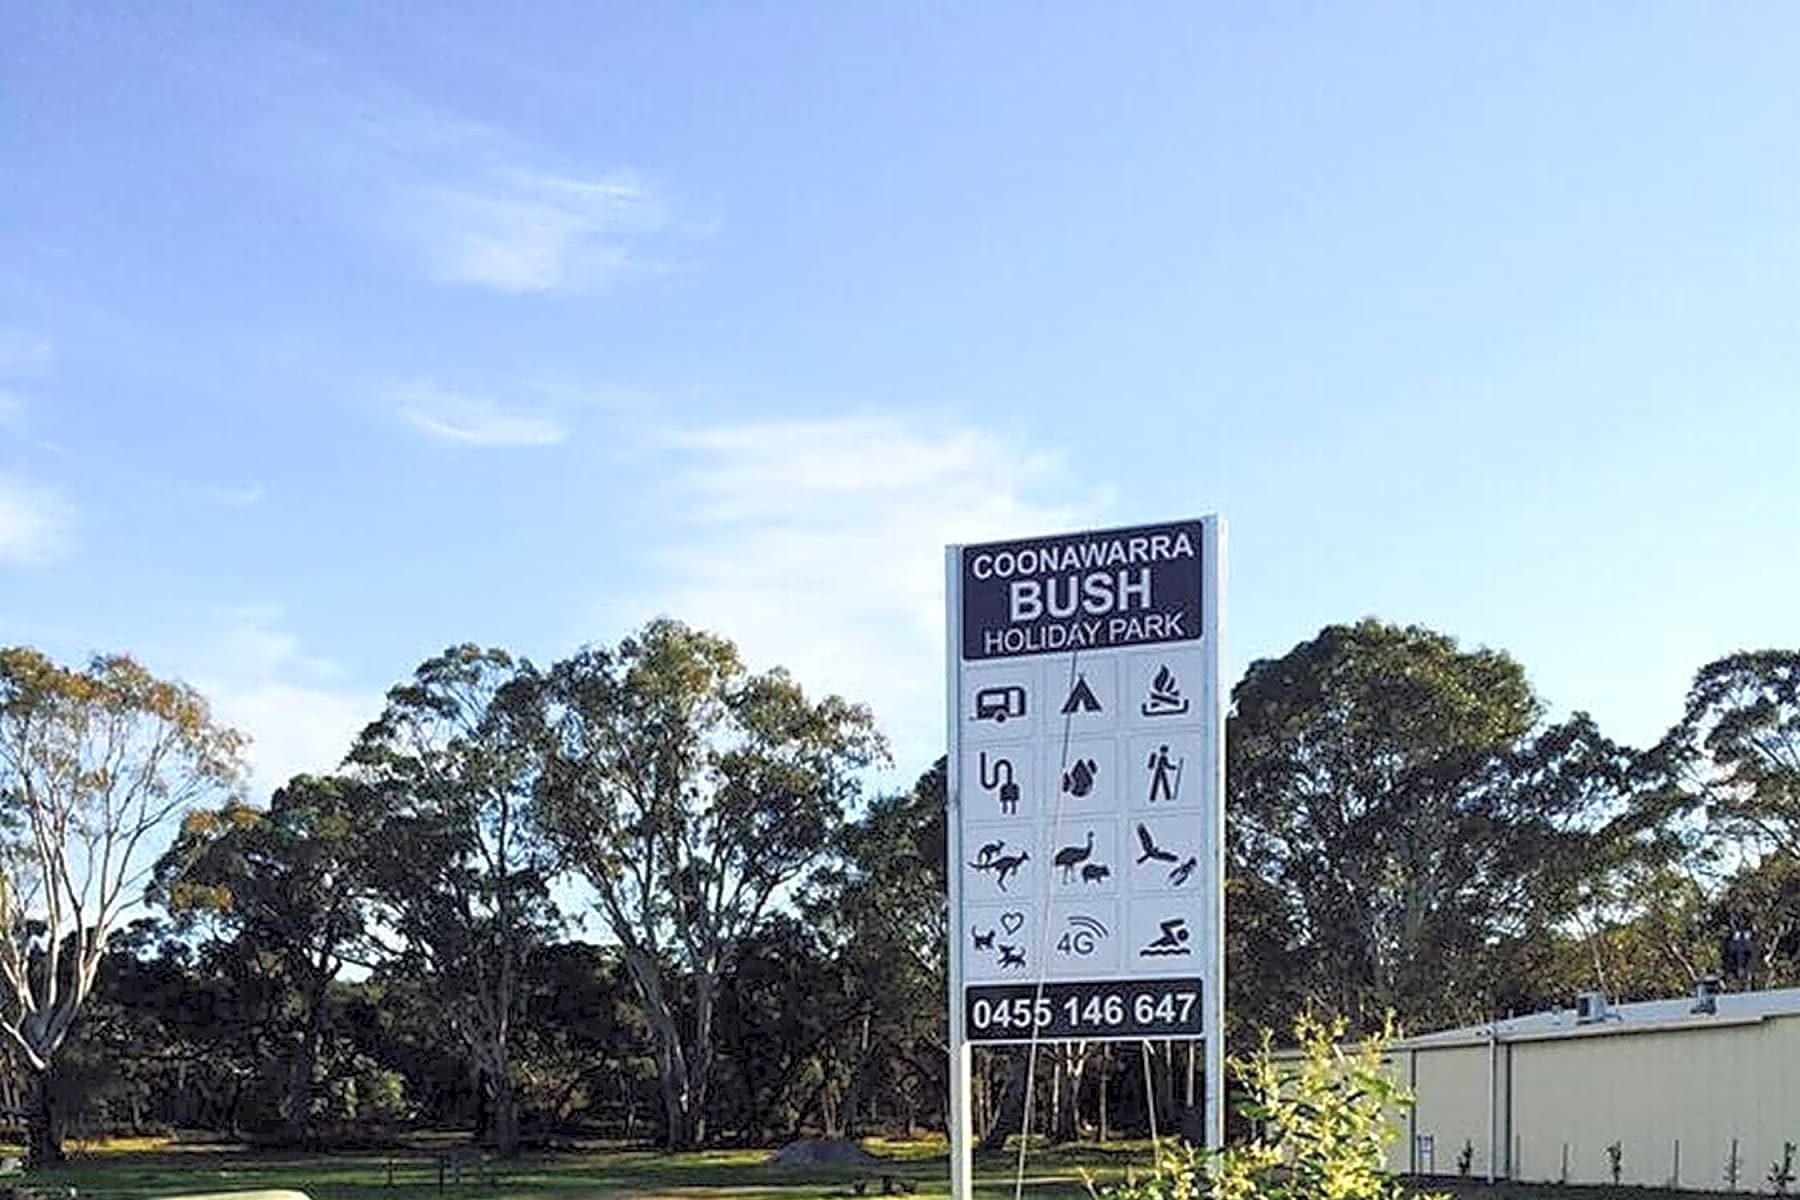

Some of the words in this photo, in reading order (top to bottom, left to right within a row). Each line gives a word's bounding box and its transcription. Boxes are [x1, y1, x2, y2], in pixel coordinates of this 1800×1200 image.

[973, 533, 1194, 579] COONAWARRA
[1010, 568, 1150, 621] BUSH
[983, 623, 1101, 654] HOLIDAY
[1109, 612, 1184, 641] PARK
[1057, 931, 1094, 955] 4G
[972, 999, 1052, 1029] 0455
[1063, 995, 1124, 1026] 146
[1134, 993, 1197, 1023] 647
